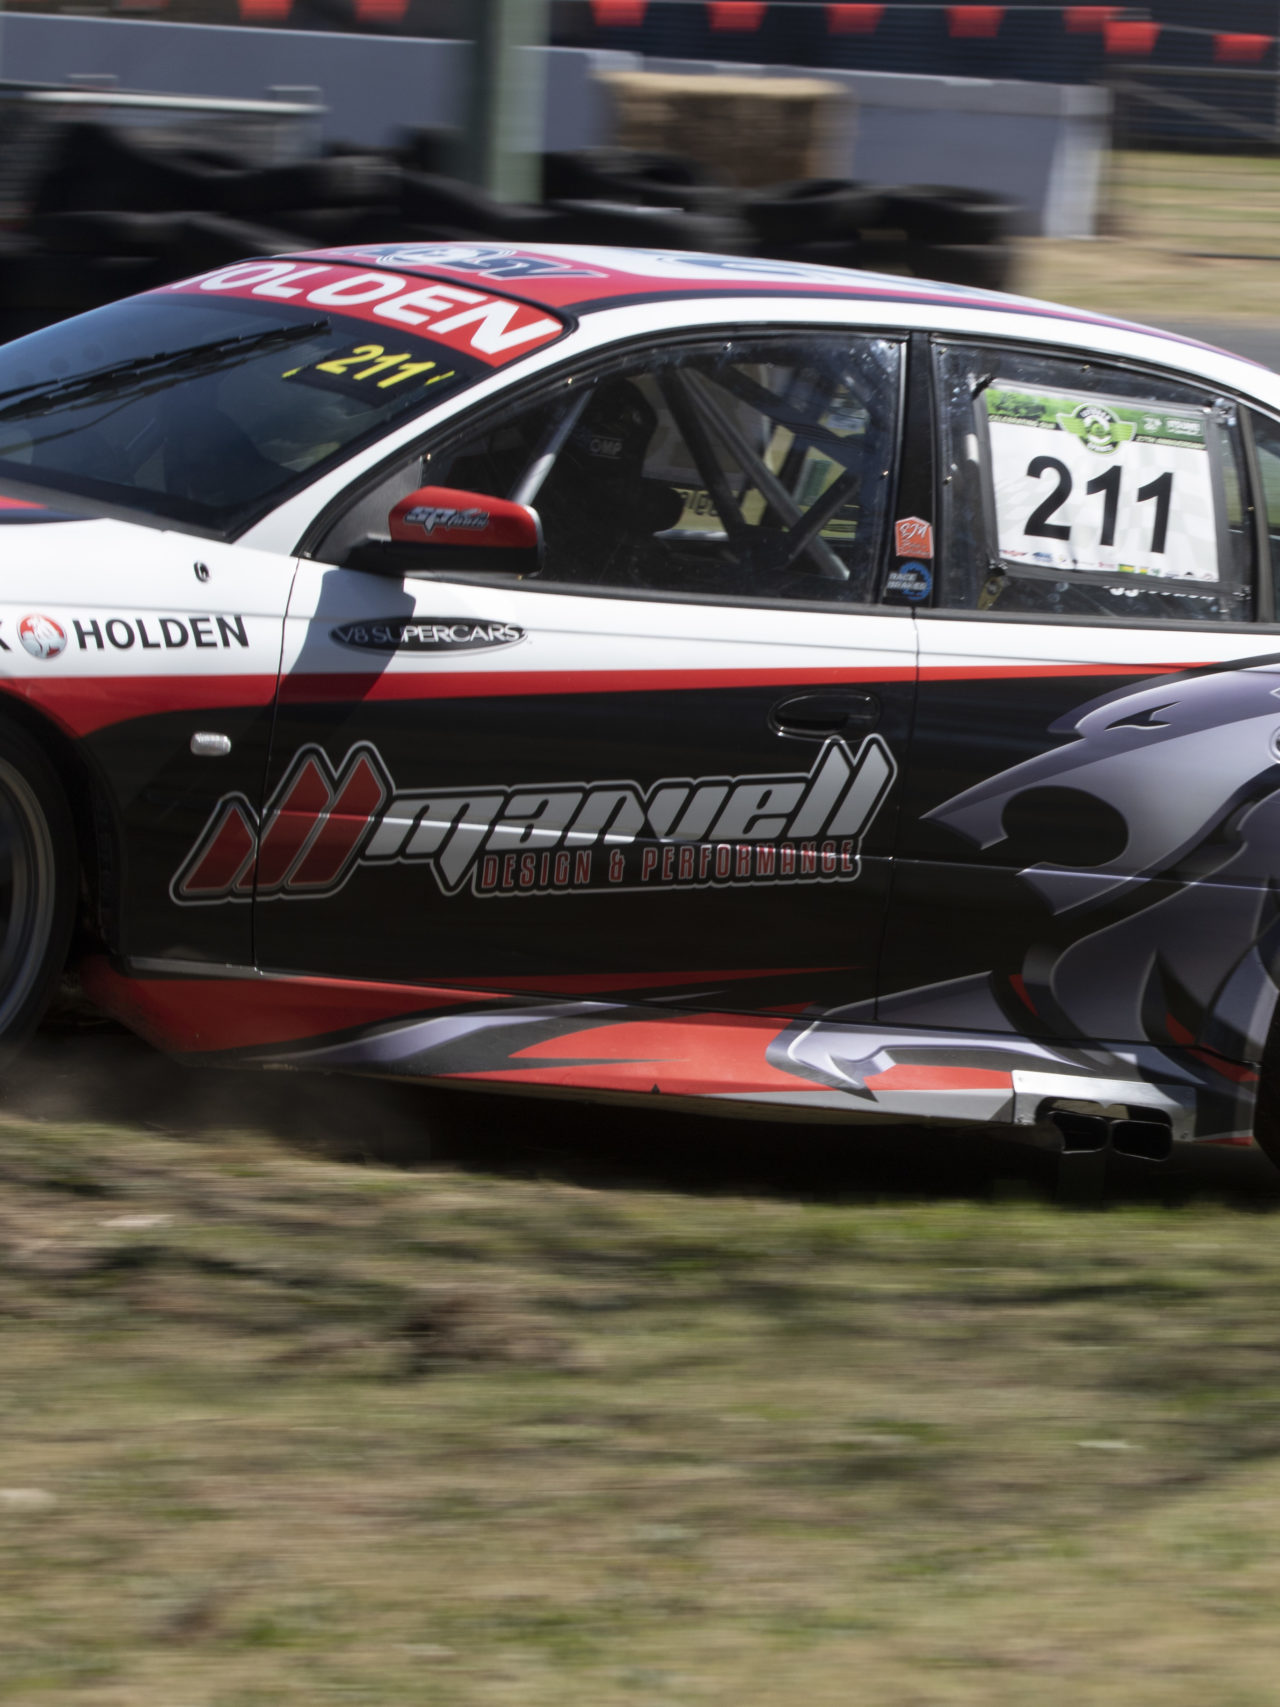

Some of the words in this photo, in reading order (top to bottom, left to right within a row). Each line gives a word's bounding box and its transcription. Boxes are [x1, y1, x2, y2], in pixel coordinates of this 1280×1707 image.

[315, 344, 436, 389] 211
[1024, 455, 1173, 554] 211
[72, 614, 250, 650] HOLDEN
[334, 626, 368, 643] V8
[372, 624, 521, 643] SUPERCARS
[482, 849, 592, 889] DESIGN
[609, 848, 625, 882] &
[641, 839, 854, 882] PERFORMANCE
